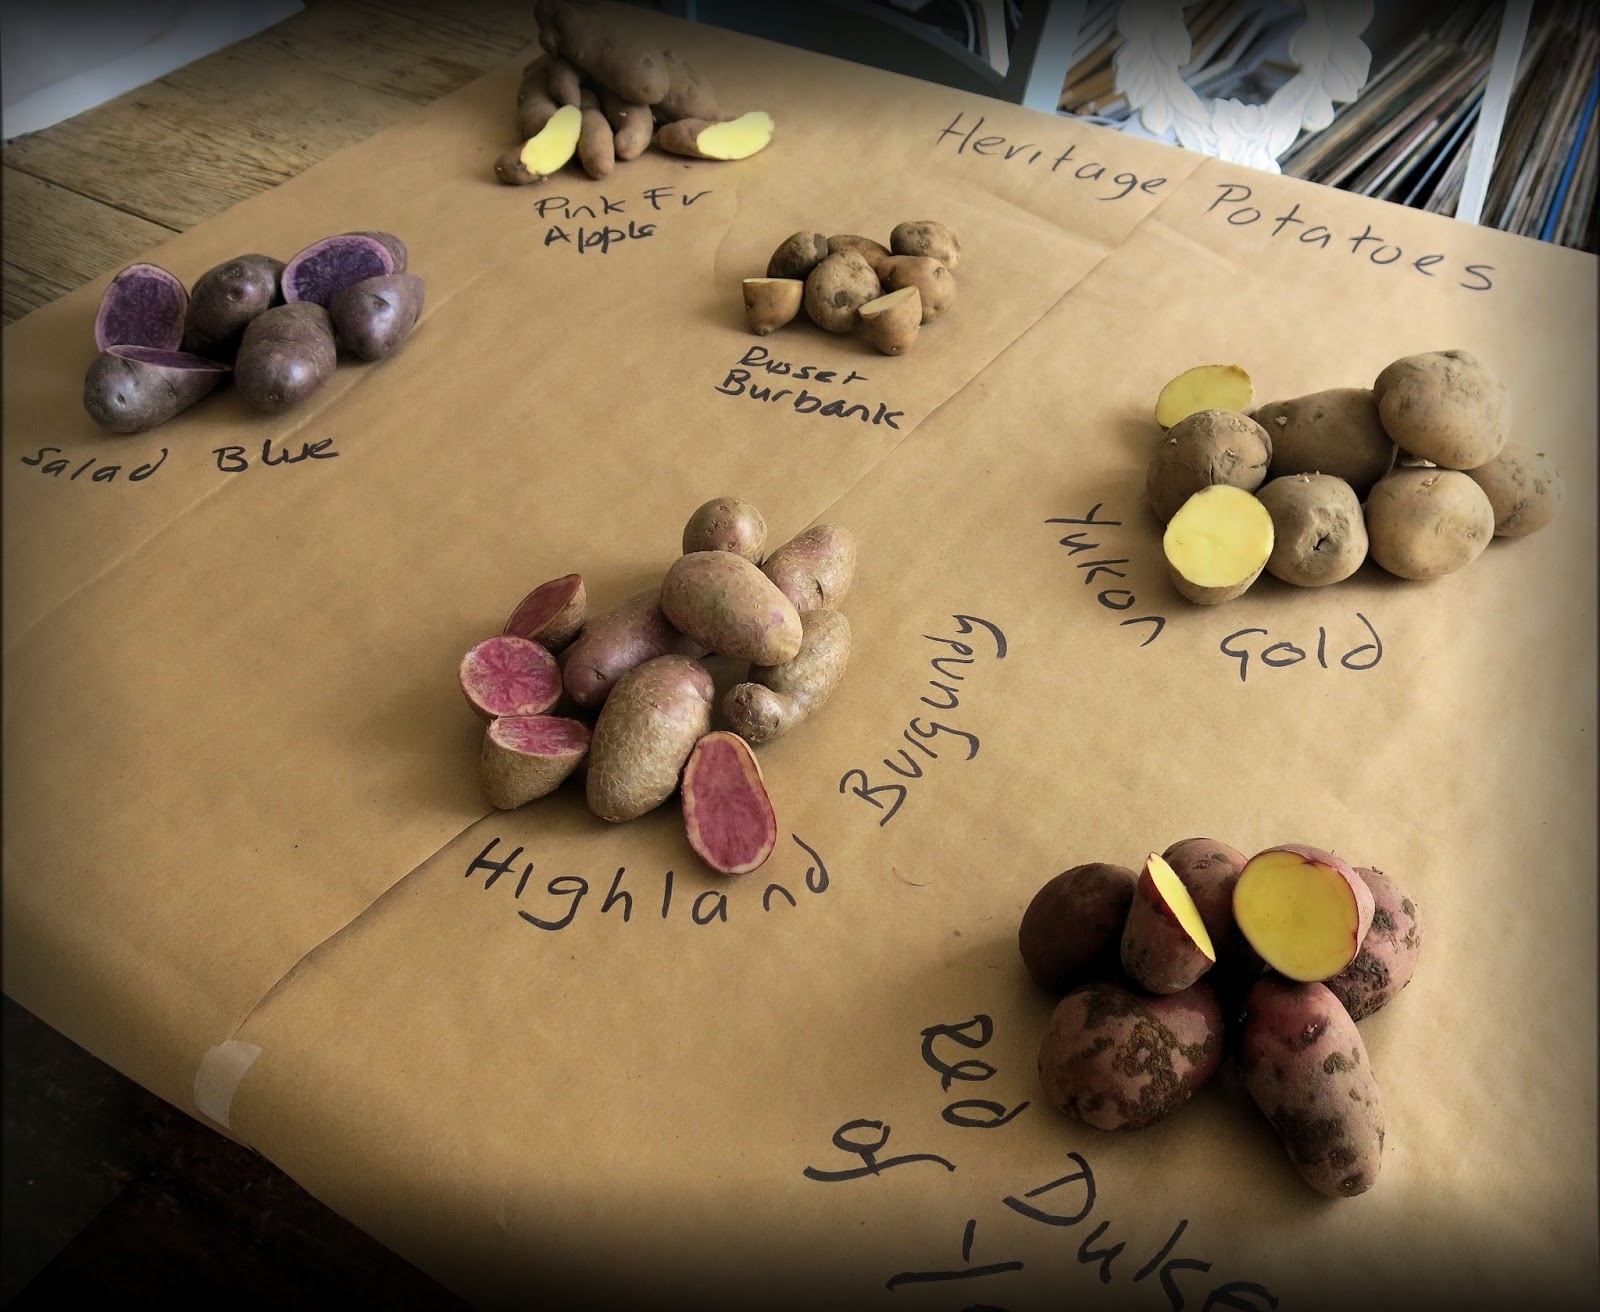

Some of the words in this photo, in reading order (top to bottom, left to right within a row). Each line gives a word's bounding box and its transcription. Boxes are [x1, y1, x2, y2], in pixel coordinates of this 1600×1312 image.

[534, 196, 627, 220] Pink
[936, 111, 1168, 201] Heritage
[1204, 184, 1497, 292] Potatoes
[544, 220, 658, 254] Apple
[737, 345, 870, 385] Russet
[714, 368, 905, 430] Burbank
[21, 447, 168, 482] Salad
[212, 437, 340, 473] Blue
[1044, 502, 1166, 647] Yukon
[1219, 612, 1384, 683] Gold
[465, 837, 830, 931] Highland
[839, 614, 1008, 827] Burgundy
[920, 1014, 1031, 1128] Red
